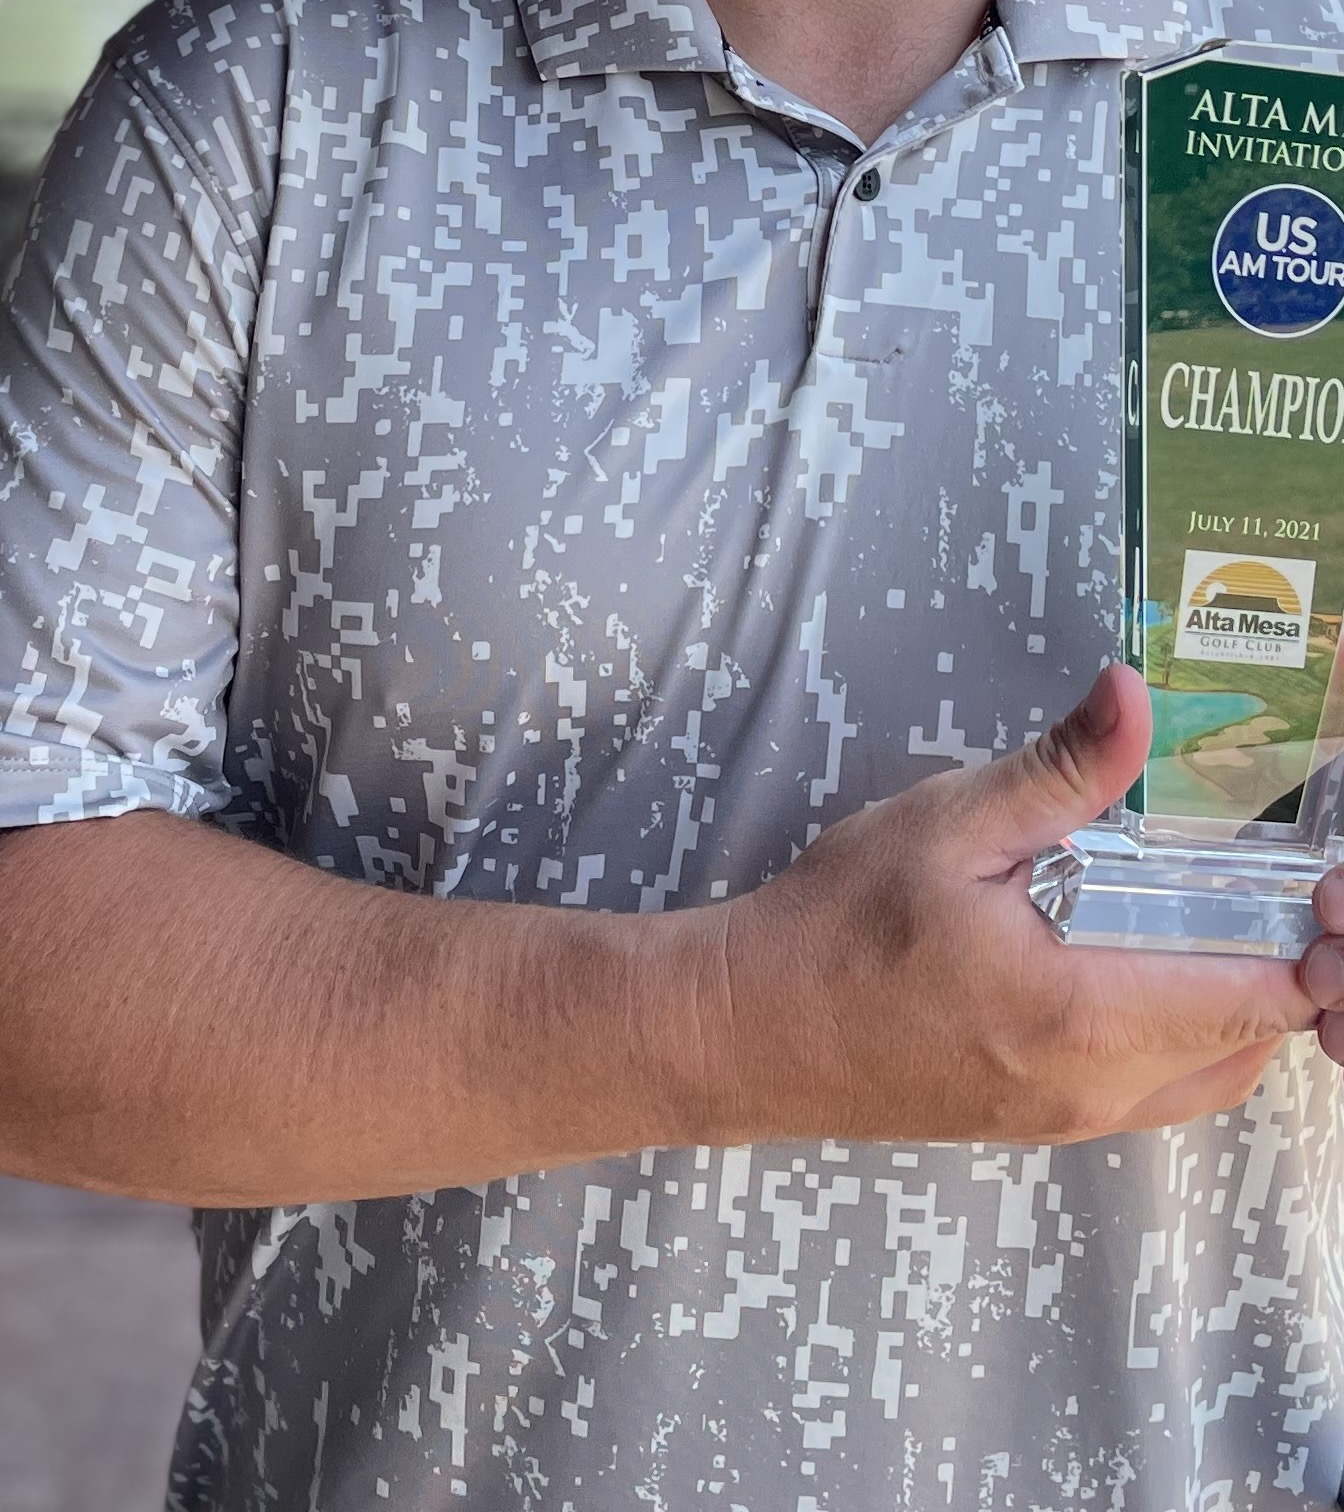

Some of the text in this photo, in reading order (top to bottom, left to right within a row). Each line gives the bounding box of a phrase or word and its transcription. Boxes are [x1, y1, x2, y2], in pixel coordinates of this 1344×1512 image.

[1189, 88, 1291, 132] ALTA
[1255, 211, 1319, 257] U.S.
[1218, 249, 1266, 279] AM
[1187, 510, 1321, 541] JULY 11, 2021
[1185, 608, 1301, 638] Alta Mesa
[1200, 635, 1282, 653] GOLF CLUB
